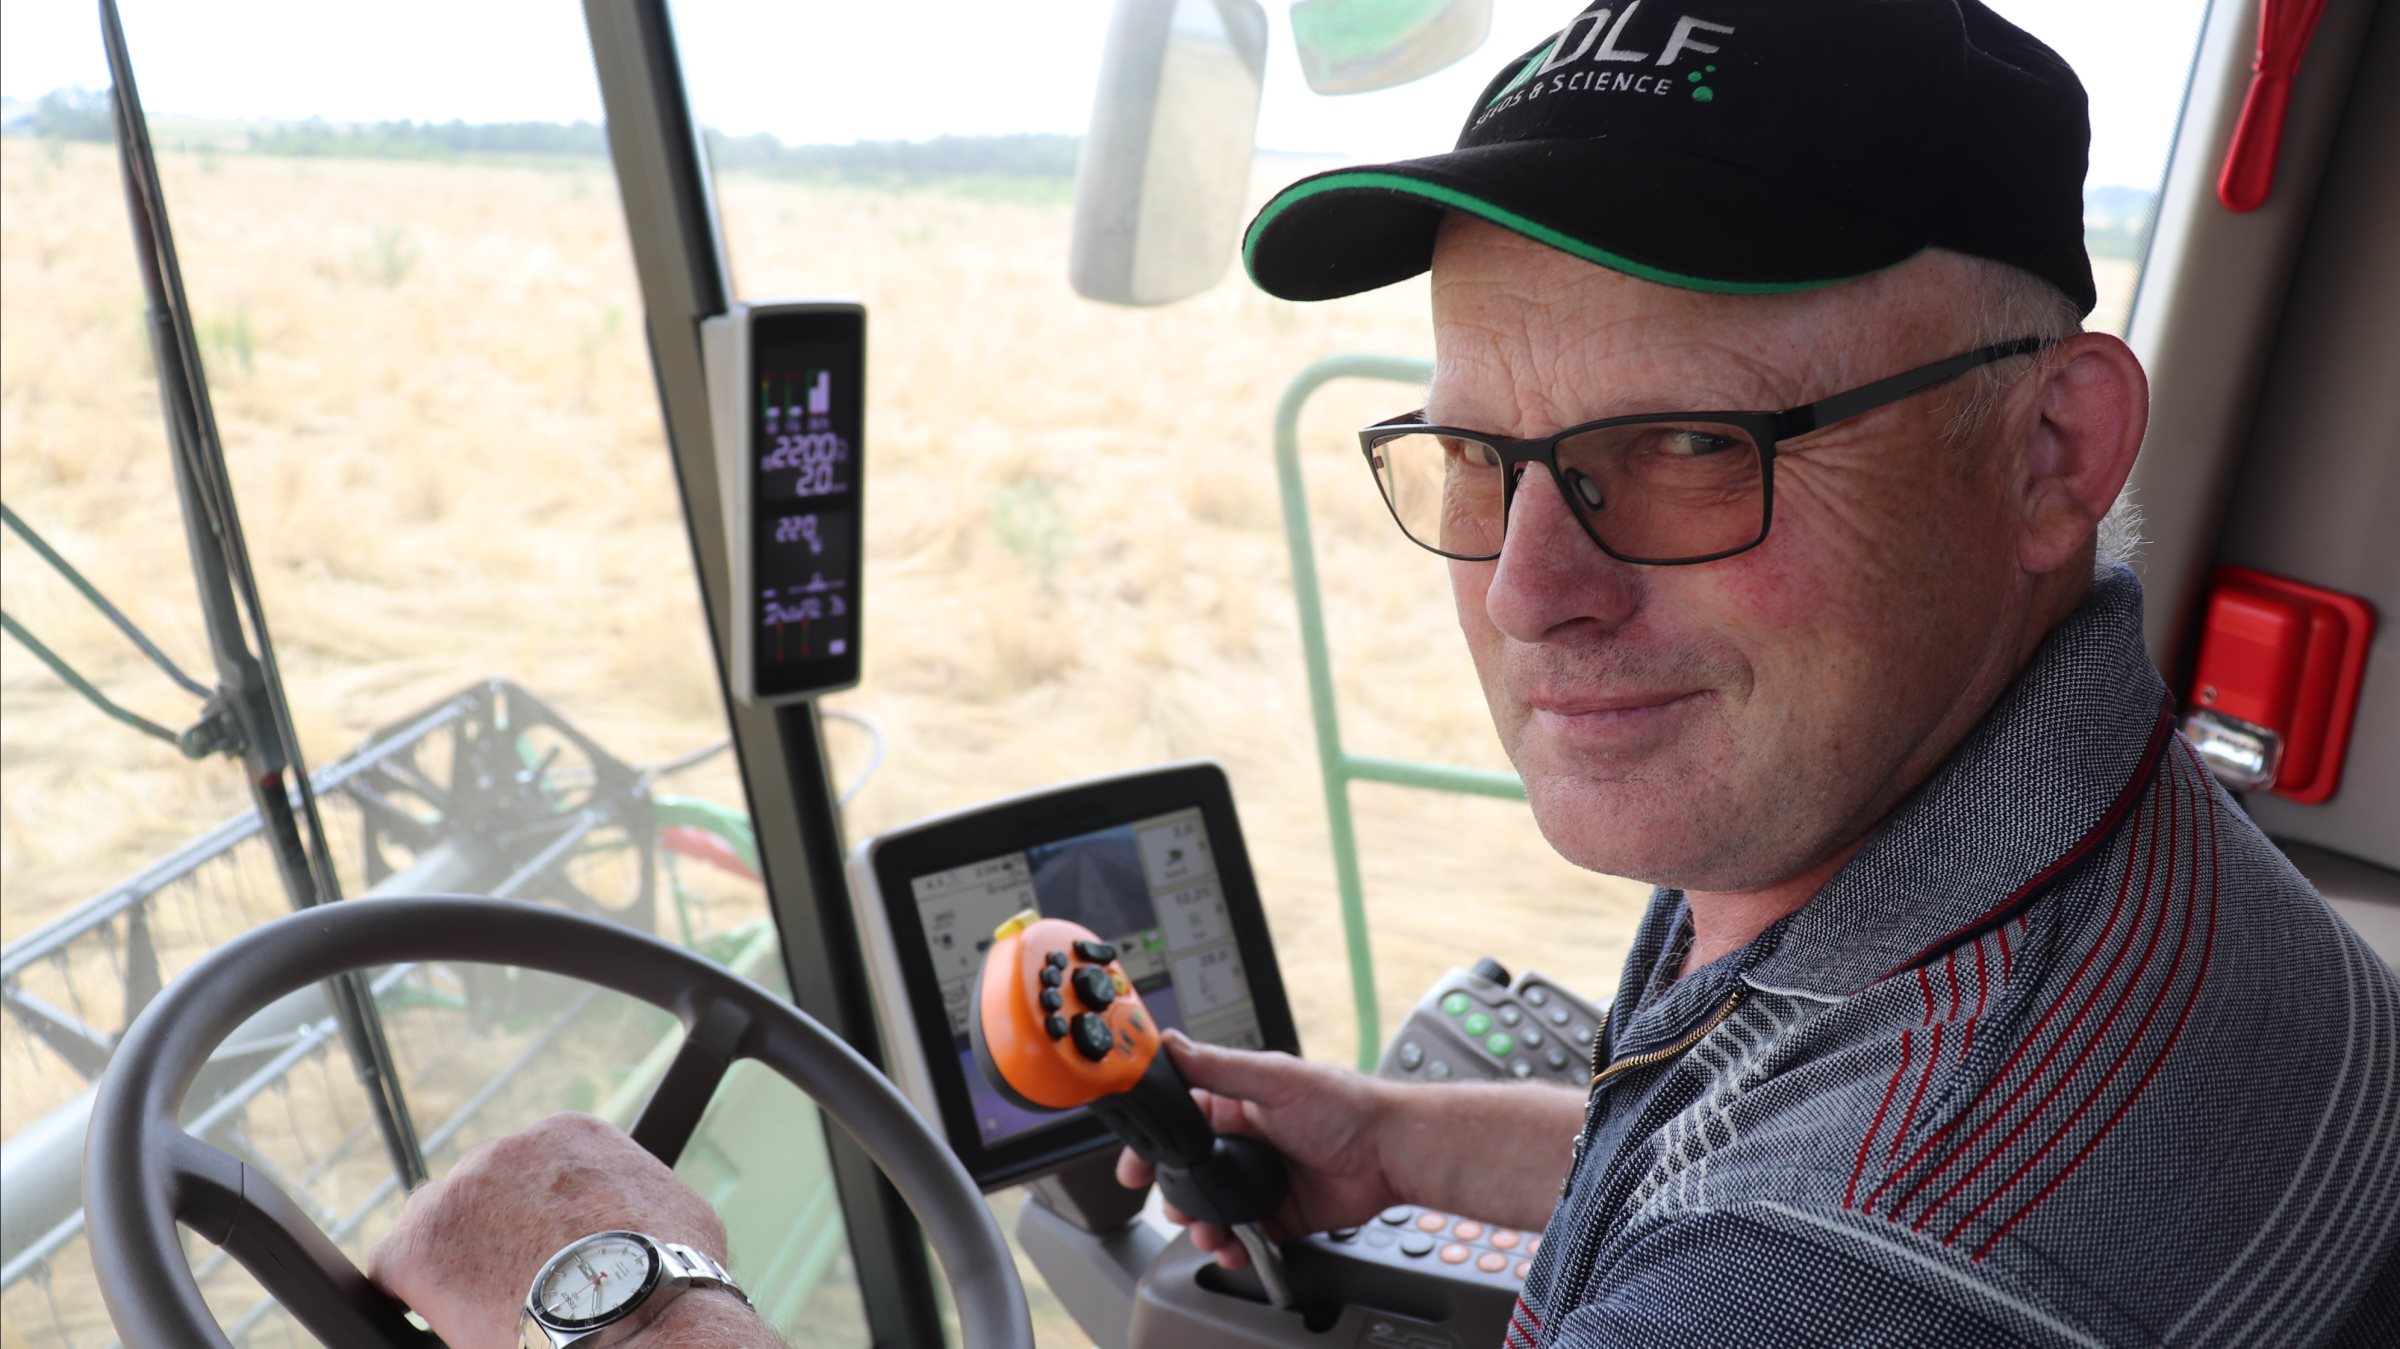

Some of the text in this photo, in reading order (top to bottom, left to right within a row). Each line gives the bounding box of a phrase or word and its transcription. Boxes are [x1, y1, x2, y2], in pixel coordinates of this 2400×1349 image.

[1536, 0, 1736, 77] DLF
[1549, 71, 1673, 96] SCIENCE
[772, 432, 837, 468] 2200
